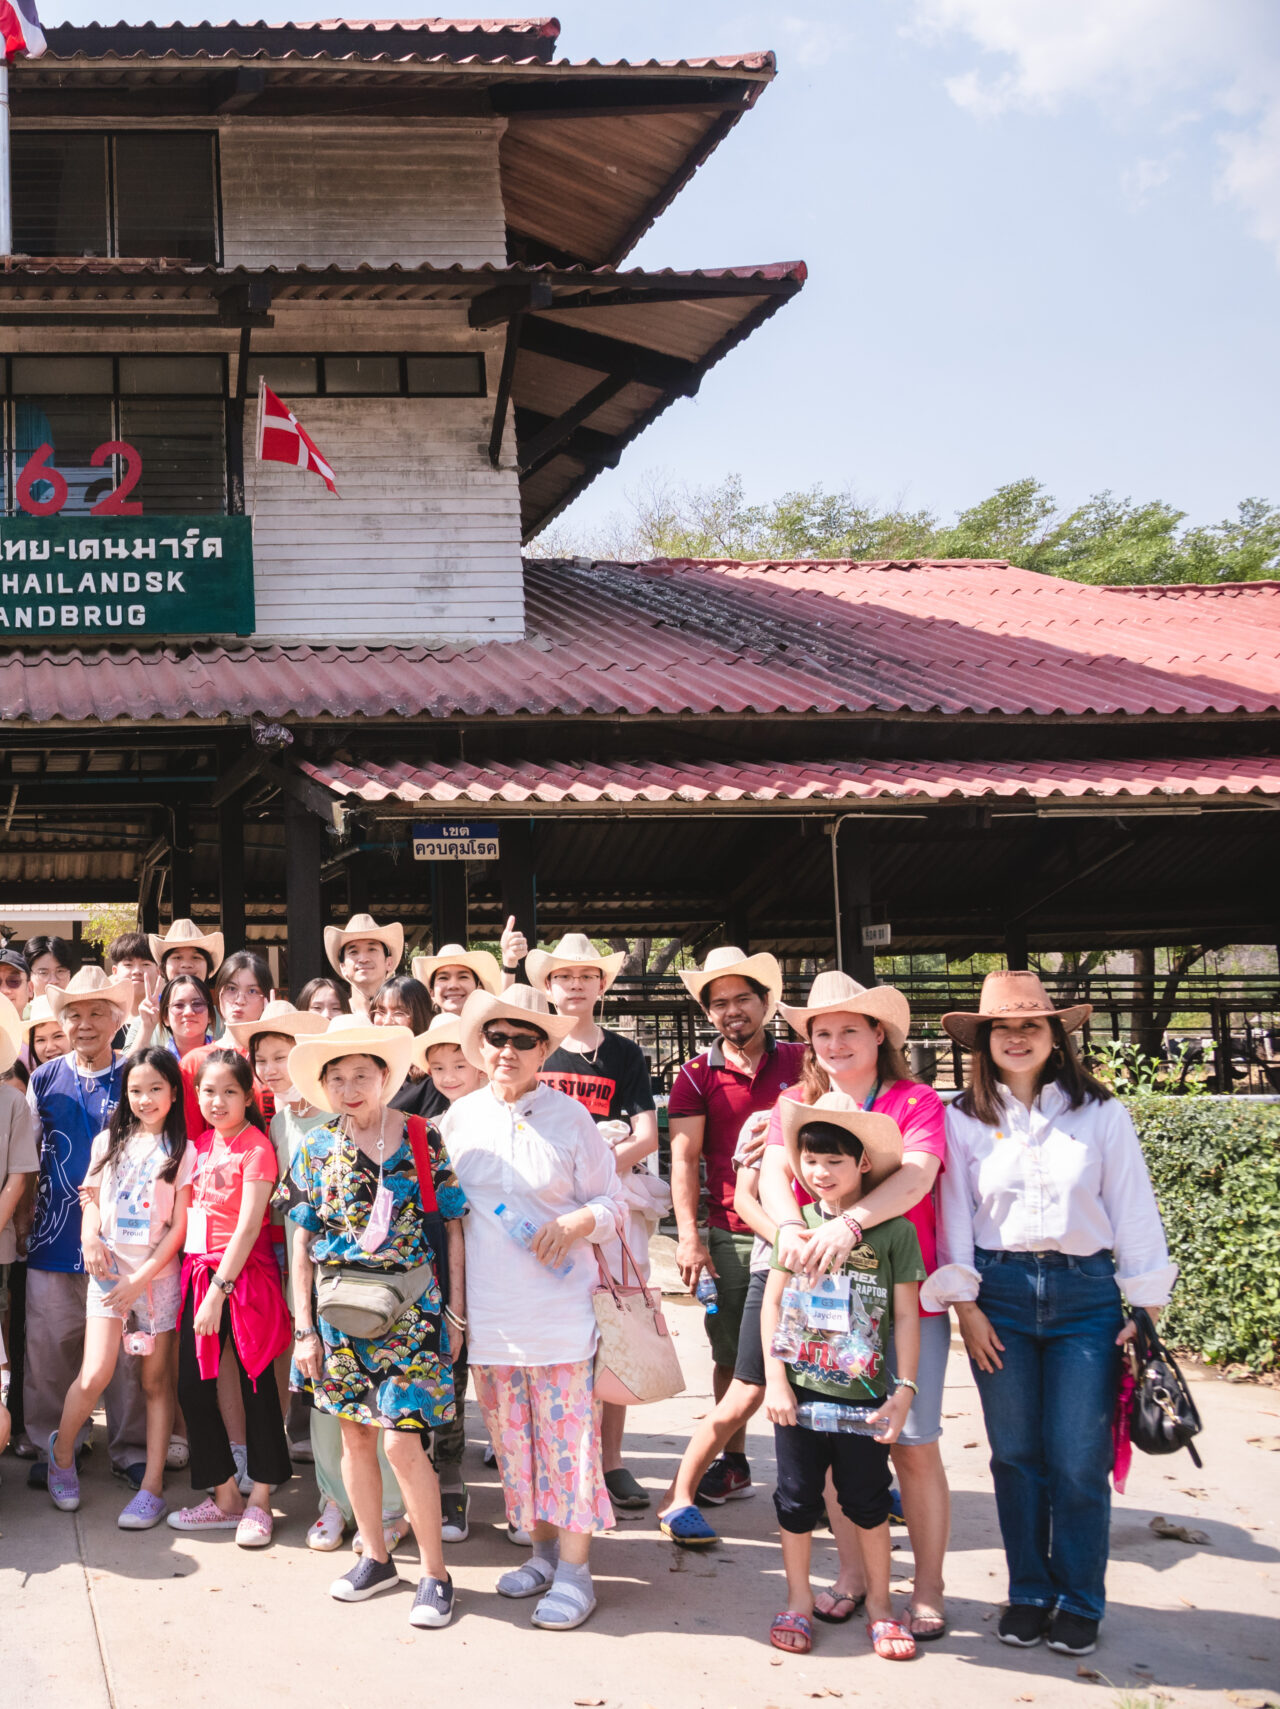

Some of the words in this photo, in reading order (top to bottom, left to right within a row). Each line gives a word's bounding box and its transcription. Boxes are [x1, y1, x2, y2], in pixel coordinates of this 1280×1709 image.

[442, 826, 470, 837] เขต
[415, 840, 497, 860] ควบคุมโรค
[559, 1079, 612, 1101] STUPID
[122, 1229, 144, 1237] Proud
[855, 1283, 888, 1299] RAPTOR
[812, 1310, 843, 1321] Jayden
